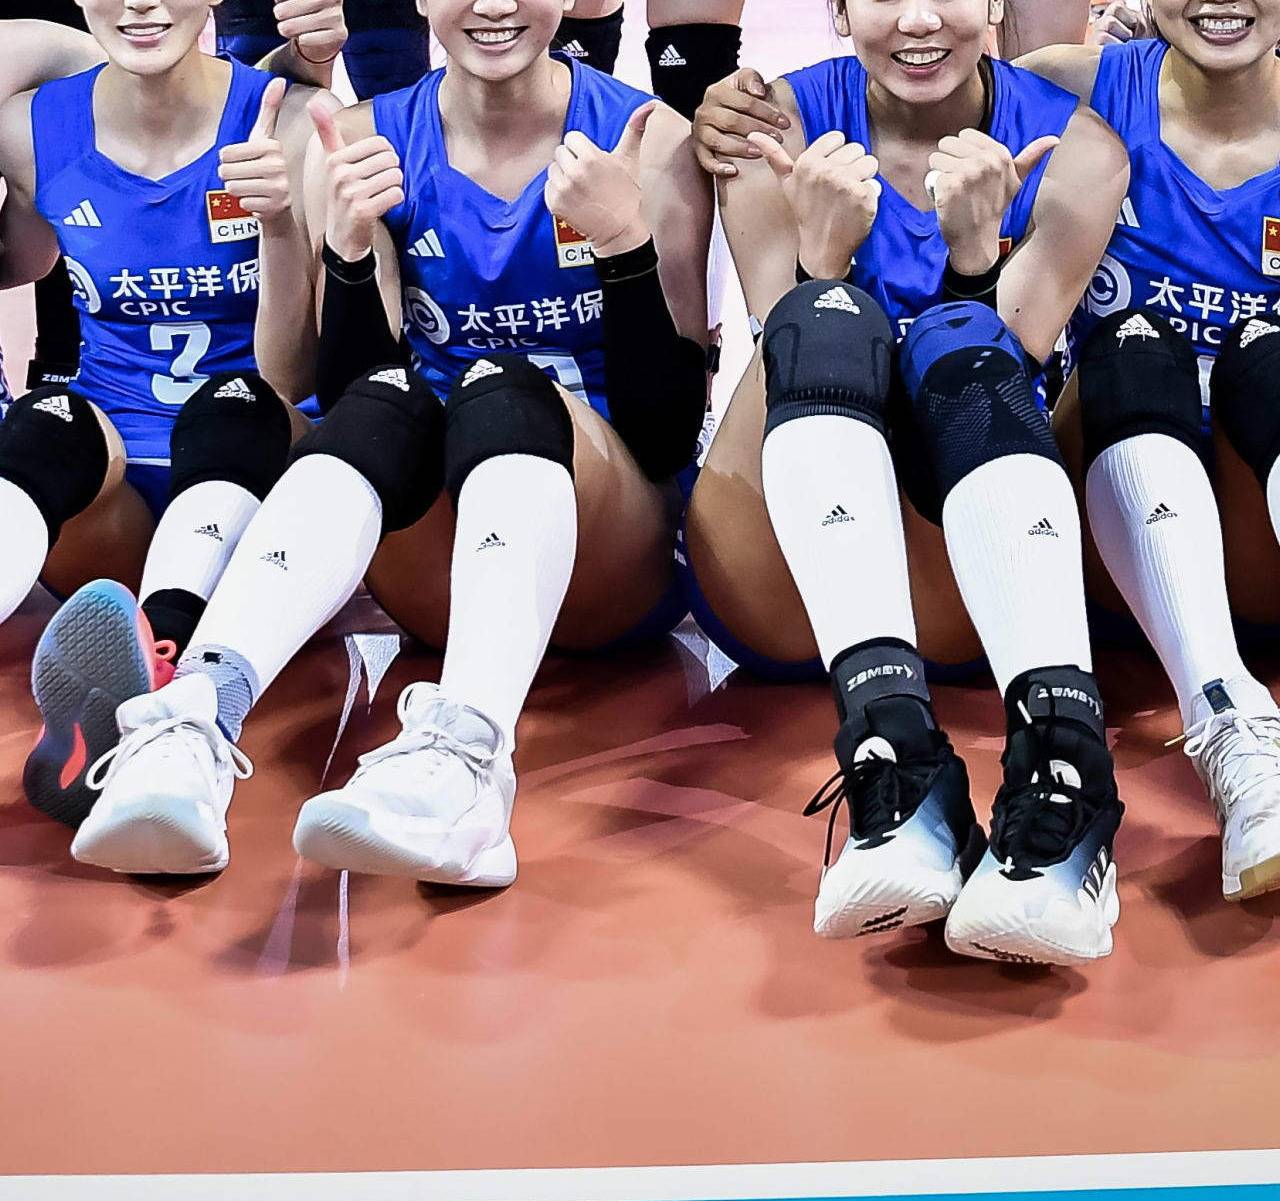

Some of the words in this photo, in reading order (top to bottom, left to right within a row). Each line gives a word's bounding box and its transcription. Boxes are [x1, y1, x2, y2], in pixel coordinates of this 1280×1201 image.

[217, 220, 260, 238] CHN
[564, 245, 595, 262] CH
[109, 261, 260, 299] 太平洋保
[119, 300, 192, 317] CPIC
[458, 288, 604, 334] 太平洋保
[466, 336, 540, 350] CPIC
[149, 321, 211, 405] 3
